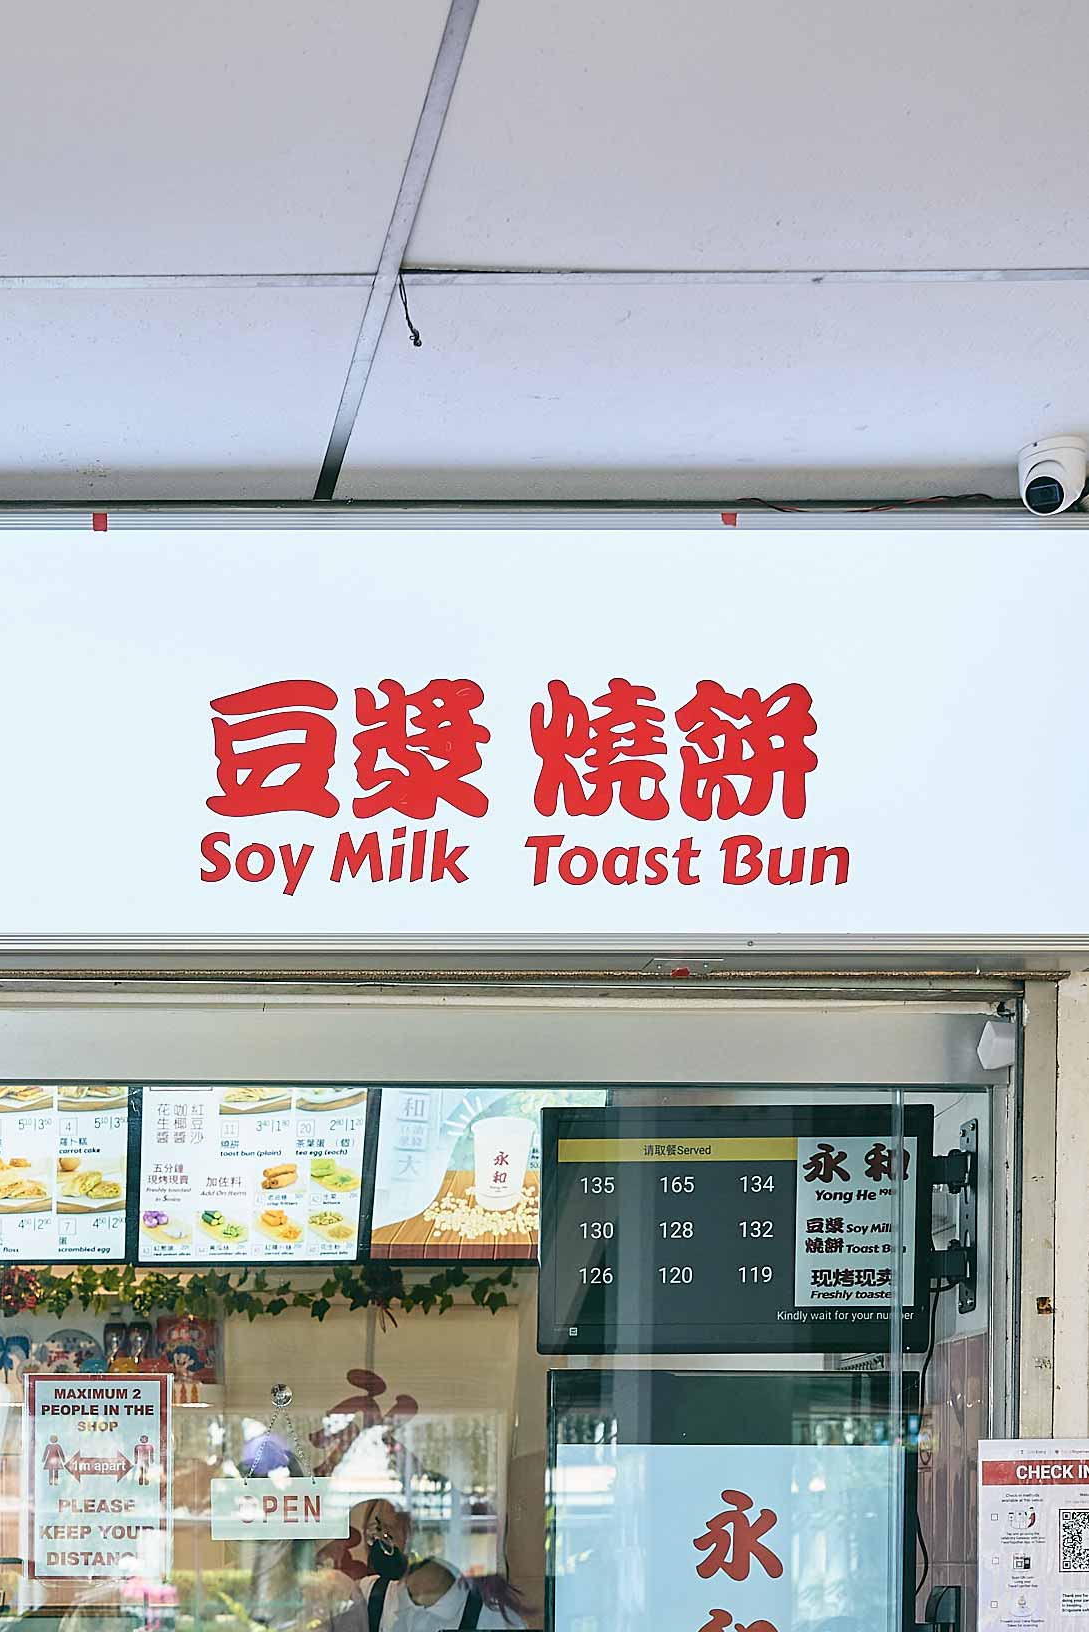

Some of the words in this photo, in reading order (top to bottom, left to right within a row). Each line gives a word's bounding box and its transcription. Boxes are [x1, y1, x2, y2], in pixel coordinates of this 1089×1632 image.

[206, 679, 491, 819] 豆漿
[530, 678, 818, 821] 燒餅
[200, 829, 315, 896] Soy
[330, 826, 470, 884] Milk
[524, 834, 703, 886] Toast
[720, 834, 851, 886] Bun
[493, 1151, 509, 1183] 永和
[581, 1176, 615, 1193] 135
[660, 1176, 695, 1193] 165
[740, 1176, 775, 1193] 134
[815, 1190, 853, 1204] Yong
[856, 1190, 877, 1201] He
[579, 1222, 614, 1238] 130
[659, 1222, 694, 1238] 128
[738, 1222, 774, 1238] 132
[846, 1223, 867, 1235] Soy
[846, 1244, 880, 1254] Toast
[579, 1267, 614, 1284] 126
[658, 1267, 693, 1284] 120
[738, 1267, 773, 1284] 119
[811, 1290, 852, 1300] Freshly
[777, 1311, 808, 1322] Kindly
[811, 1311, 832, 1320] wait
[834, 1311, 849, 1320] for
[851, 1313, 874, 1322] your
[54, 1389, 128, 1399] MAXIMUM
[132, 1389, 141, 1399] 2
[41, 1405, 99, 1415] PEOPLE
[104, 1405, 119, 1415] IN
[123, 1405, 154, 1415] THE
[77, 1421, 118, 1432] SHOP
[73, 1462, 90, 1471] 1m
[94, 1462, 126, 1473] apart
[1016, 1465, 1074, 1479] CHECK
[58, 1499, 135, 1513] PLEASE
[40, 1526, 92, 1539] KEEP
